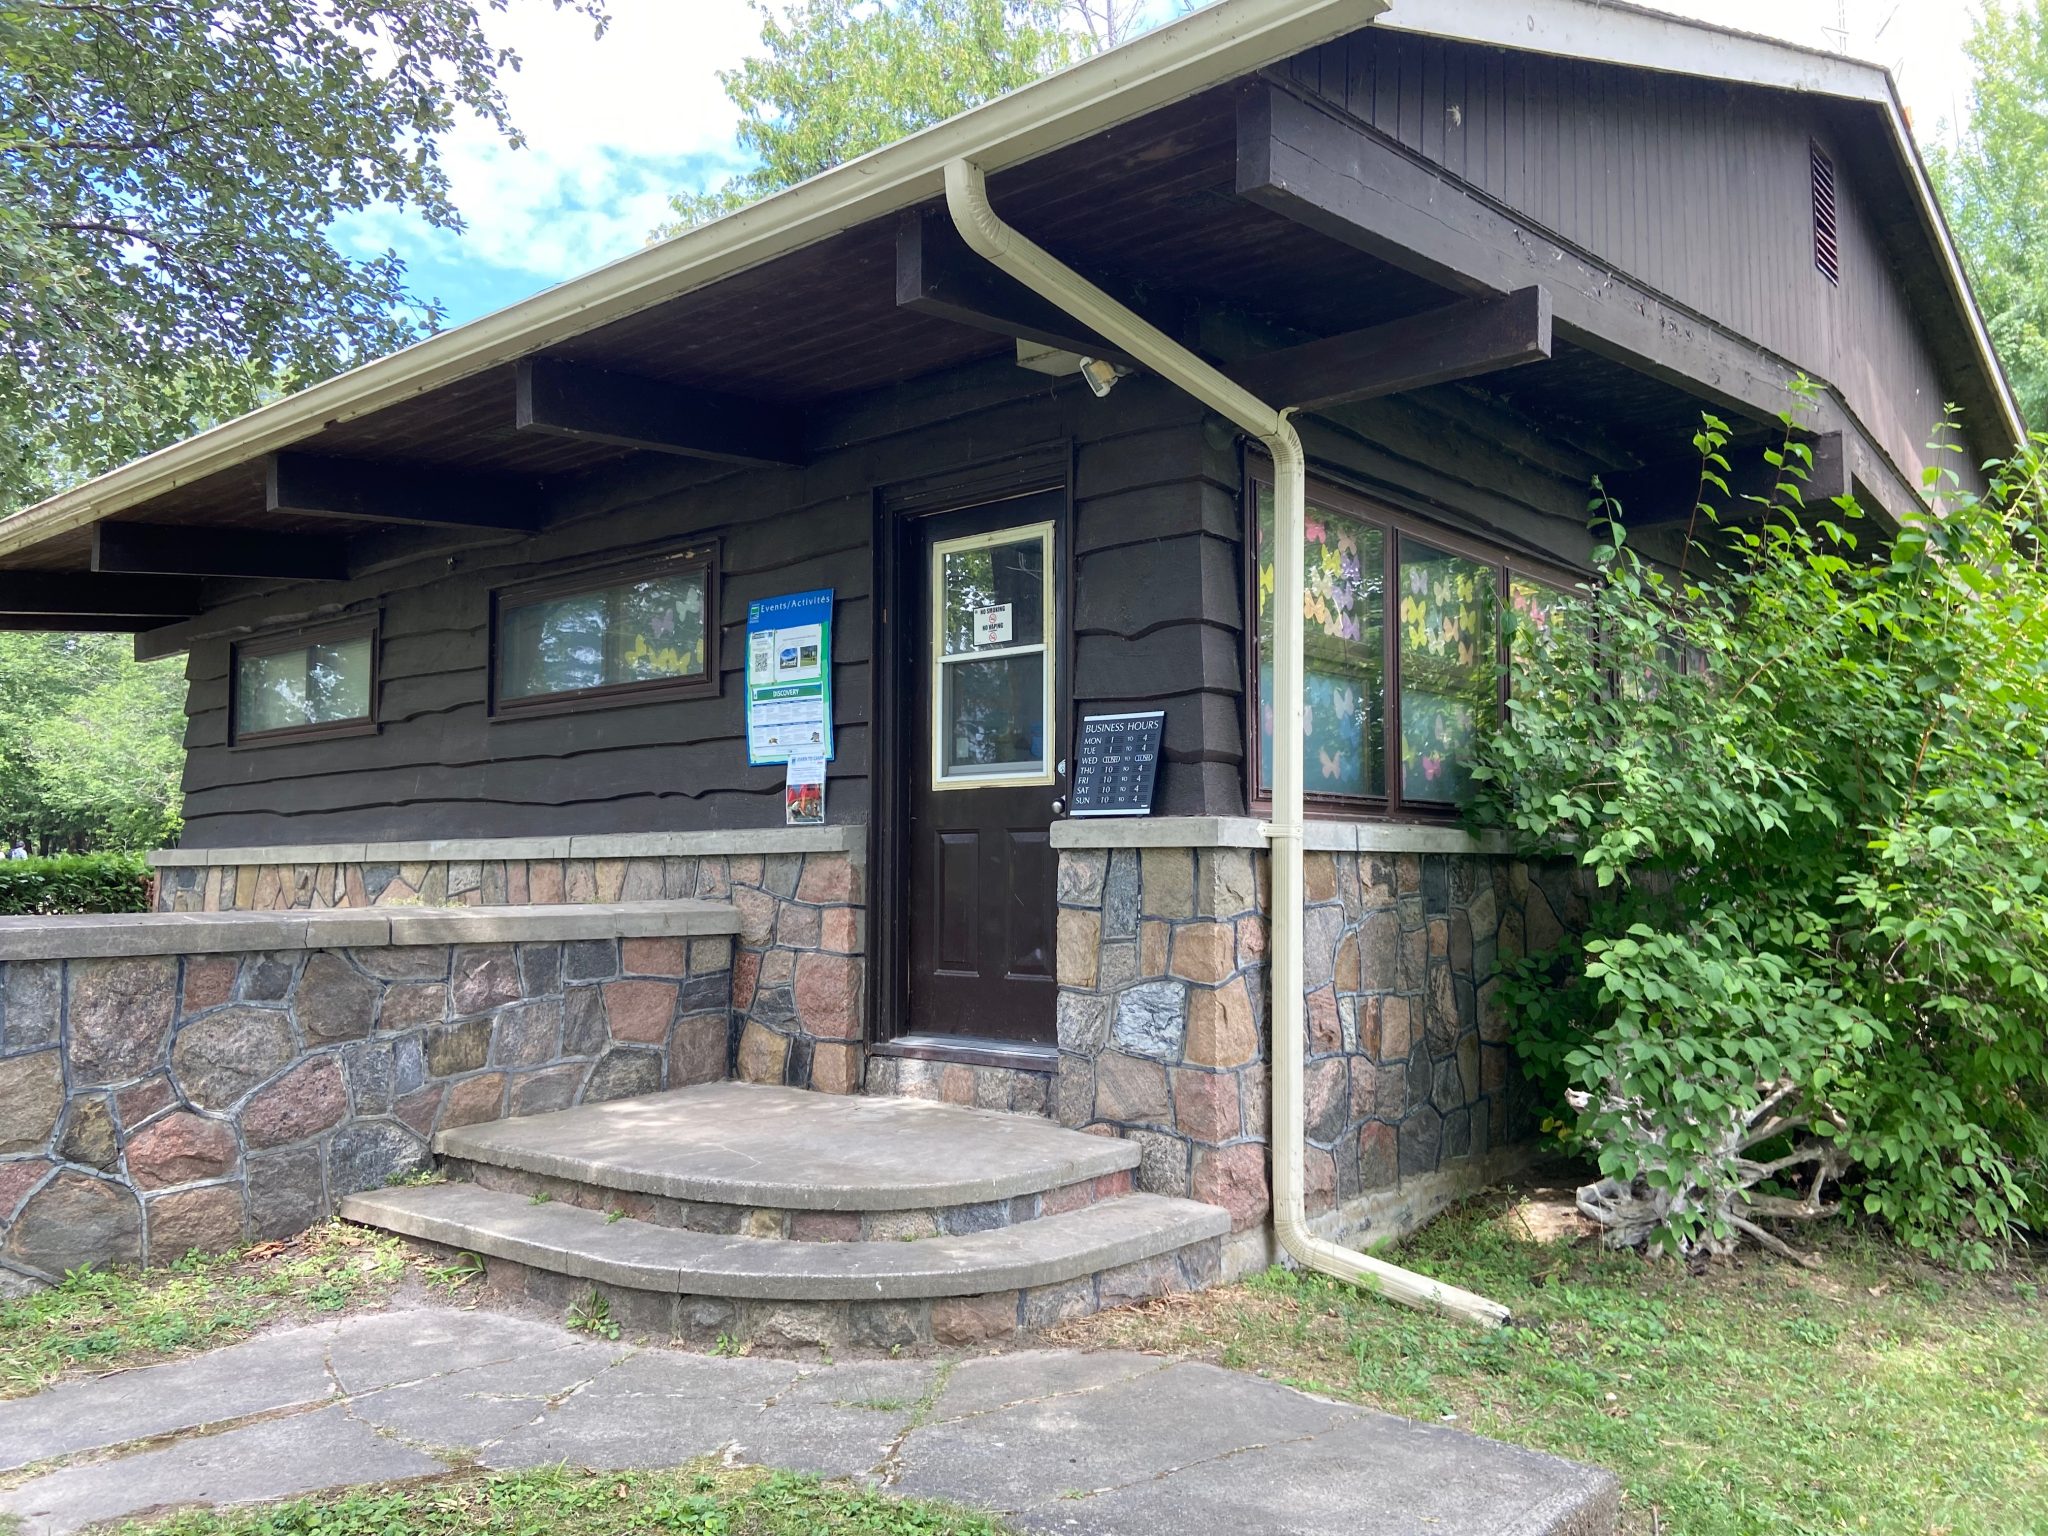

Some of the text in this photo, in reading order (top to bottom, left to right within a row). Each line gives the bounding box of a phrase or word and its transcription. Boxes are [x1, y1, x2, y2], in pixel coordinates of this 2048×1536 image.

[761, 596, 830, 613] Events/Activités
[987, 606, 1005, 614] SMOKING
[772, 688, 799, 697] DISCOVERY
[1085, 720, 1159, 733] BUSINESS HOURS
[1084, 737, 1102, 745] MON
[1142, 734, 1148, 742] 4
[1141, 744, 1146, 752] 4
[1080, 767, 1095, 775] THU
[1138, 764, 1143, 772] 4
[1078, 776, 1089, 784] FRI
[1136, 774, 1141, 782] 4
[1077, 786, 1090, 794] SAT
[1075, 796, 1090, 804] SUN
[1132, 795, 1138, 803] 4
